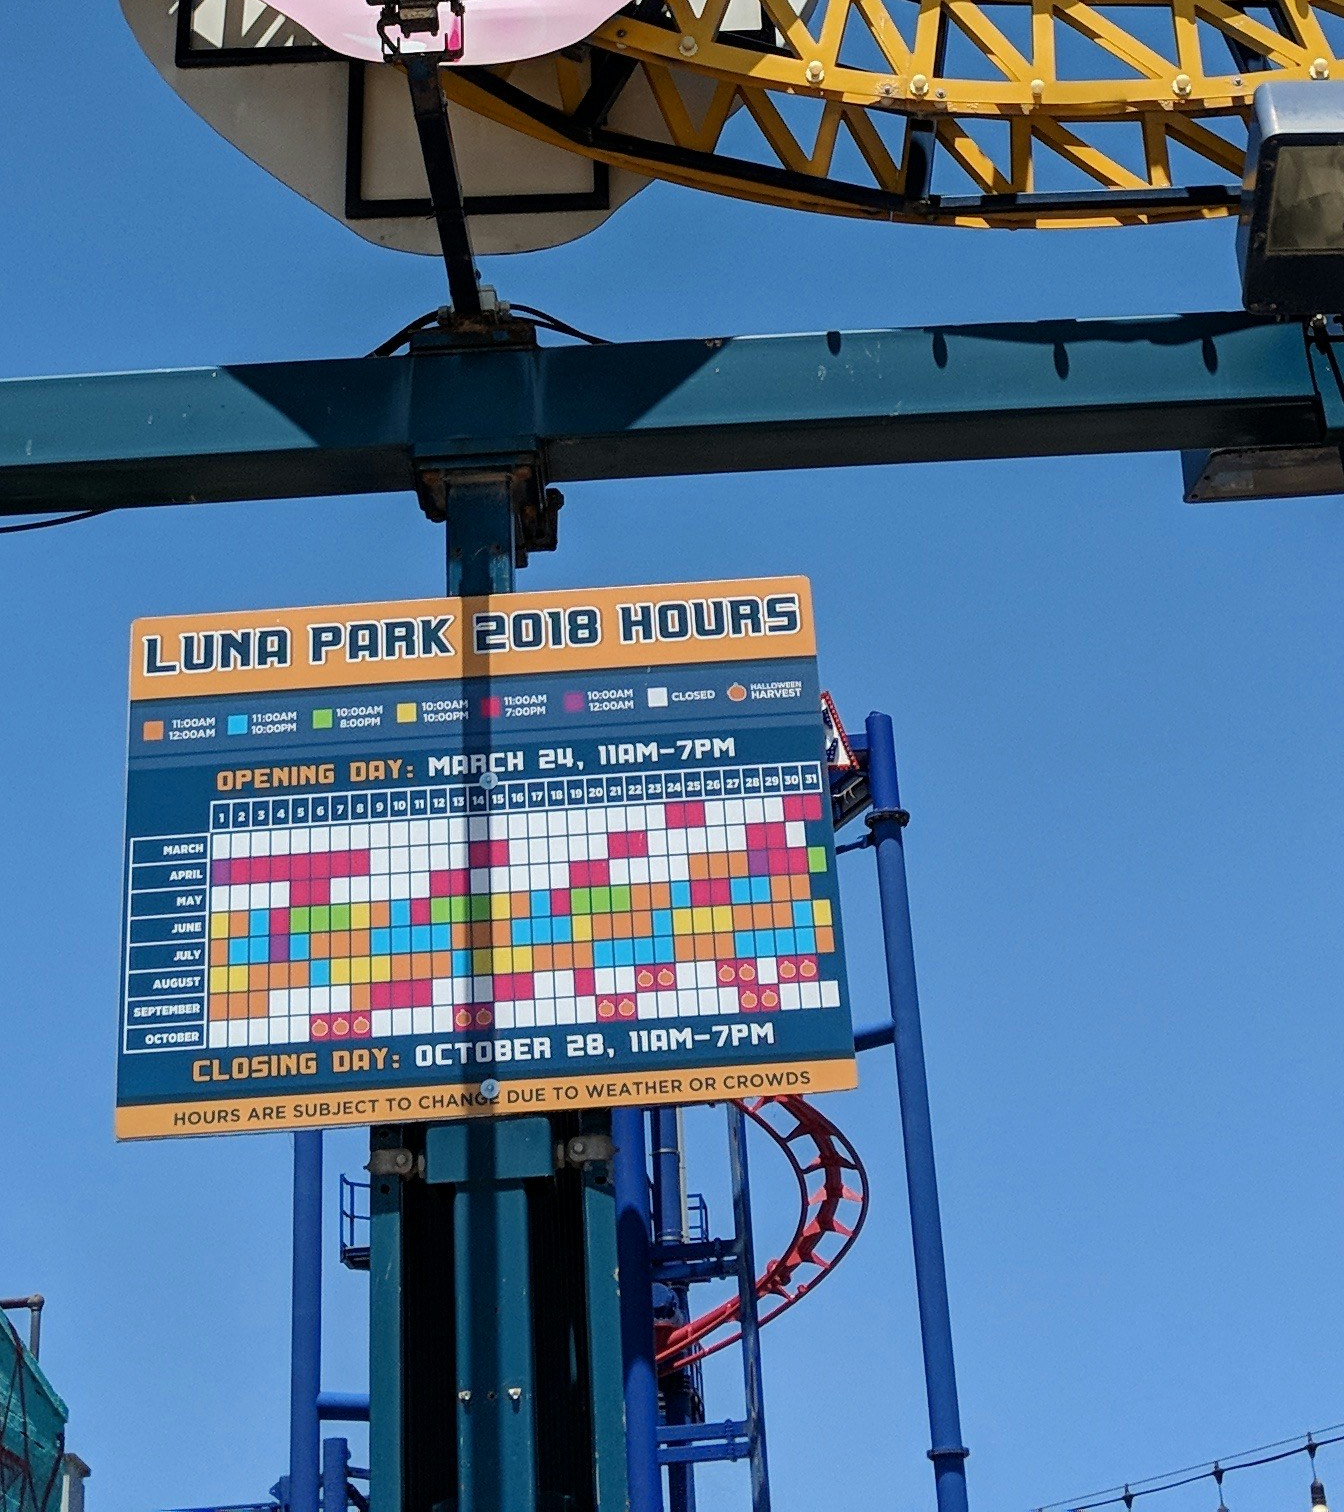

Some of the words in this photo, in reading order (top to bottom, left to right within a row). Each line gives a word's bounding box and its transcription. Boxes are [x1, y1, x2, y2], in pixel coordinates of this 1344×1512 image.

[143, 626, 292, 676] LUNA
[307, 614, 455, 666] PARK
[473, 606, 602, 654] 2018
[617, 593, 801, 645] HOURS
[750, 681, 802, 690] HALLOWEEN
[504, 694, 547, 705] 11:00AM
[587, 689, 634, 700] 10:00AM
[672, 689, 715, 702] CLOSED
[751, 688, 802, 700] HARVEST
[336, 705, 383, 716] 10:00AM
[422, 699, 469, 711] 10:00AM
[505, 705, 546, 716] 7:00PM
[588, 700, 634, 711] 12:00AM
[171, 717, 215, 728] 11:00AM
[252, 711, 297, 722] 11:00AM
[340, 717, 381, 728] 8:00PM
[423, 711, 469, 723] 10:00PM
[168, 728, 215, 740] 12:00AM
[251, 723, 297, 734] 10:00PM
[216, 764, 335, 791] OPENING
[349, 759, 414, 783] DAY:
[428, 751, 524, 778] MARCH
[538, 747, 584, 771] 24,
[598, 737, 736, 763] 11AM-7PM
[218, 813, 225, 823] 1
[238, 812, 245, 822] 2
[258, 811, 265, 820] 3
[277, 809, 285, 819] 4
[297, 808, 304, 818] 5
[316, 806, 324, 816] 6
[336, 805, 344, 815] 7
[356, 803, 364, 813] 8
[376, 802, 384, 812] 9
[393, 801, 406, 811] 10
[414, 799, 425, 809] 11
[433, 798, 445, 808] 12
[453, 797, 465, 807] 13
[472, 795, 485, 805] 14
[492, 794, 504, 804] 15
[511, 792, 524, 803] 16
[531, 791, 543, 801] 17
[551, 790, 563, 800] 18
[570, 789, 582, 799] 19
[589, 787, 604, 798] 20
[609, 786, 622, 796] 21
[628, 785, 642, 795] 22
[647, 783, 661, 794] 23
[667, 782, 681, 793] 24
[687, 781, 701, 791] 25
[706, 780, 721, 790] 26
[726, 779, 739, 789] 27
[745, 777, 760, 788] 28
[765, 776, 779, 786] 29
[784, 775, 799, 785] 30
[804, 774, 817, 784] 31
[163, 843, 204, 855] MARCH
[170, 869, 203, 881] APRIL
[176, 895, 202, 907] MAY
[171, 922, 202, 934] JUNE
[174, 949, 201, 961] JULY
[152, 977, 201, 989] AUGUST
[133, 1003, 201, 1017] SEPTEMBER
[145, 1031, 199, 1044] OCTOBER
[192, 1052, 317, 1083] CLOSING
[332, 1047, 401, 1072] DAY:
[415, 1037, 551, 1068] OCTOBER
[566, 1033, 615, 1058] 28,
[629, 1022, 775, 1053] 11AM-7PM
[174, 1107, 240, 1126] HOURS
[247, 1105, 286, 1121] ARE
[293, 1099, 378, 1119] SUBJECT
[385, 1097, 412, 1113] TO
[507, 1087, 546, 1104] DUE
[553, 1085, 579, 1100] TO
[585, 1078, 682, 1098] WEATHER
[690, 1076, 716, 1092] OR
[723, 1070, 811, 1089] CROWDS
